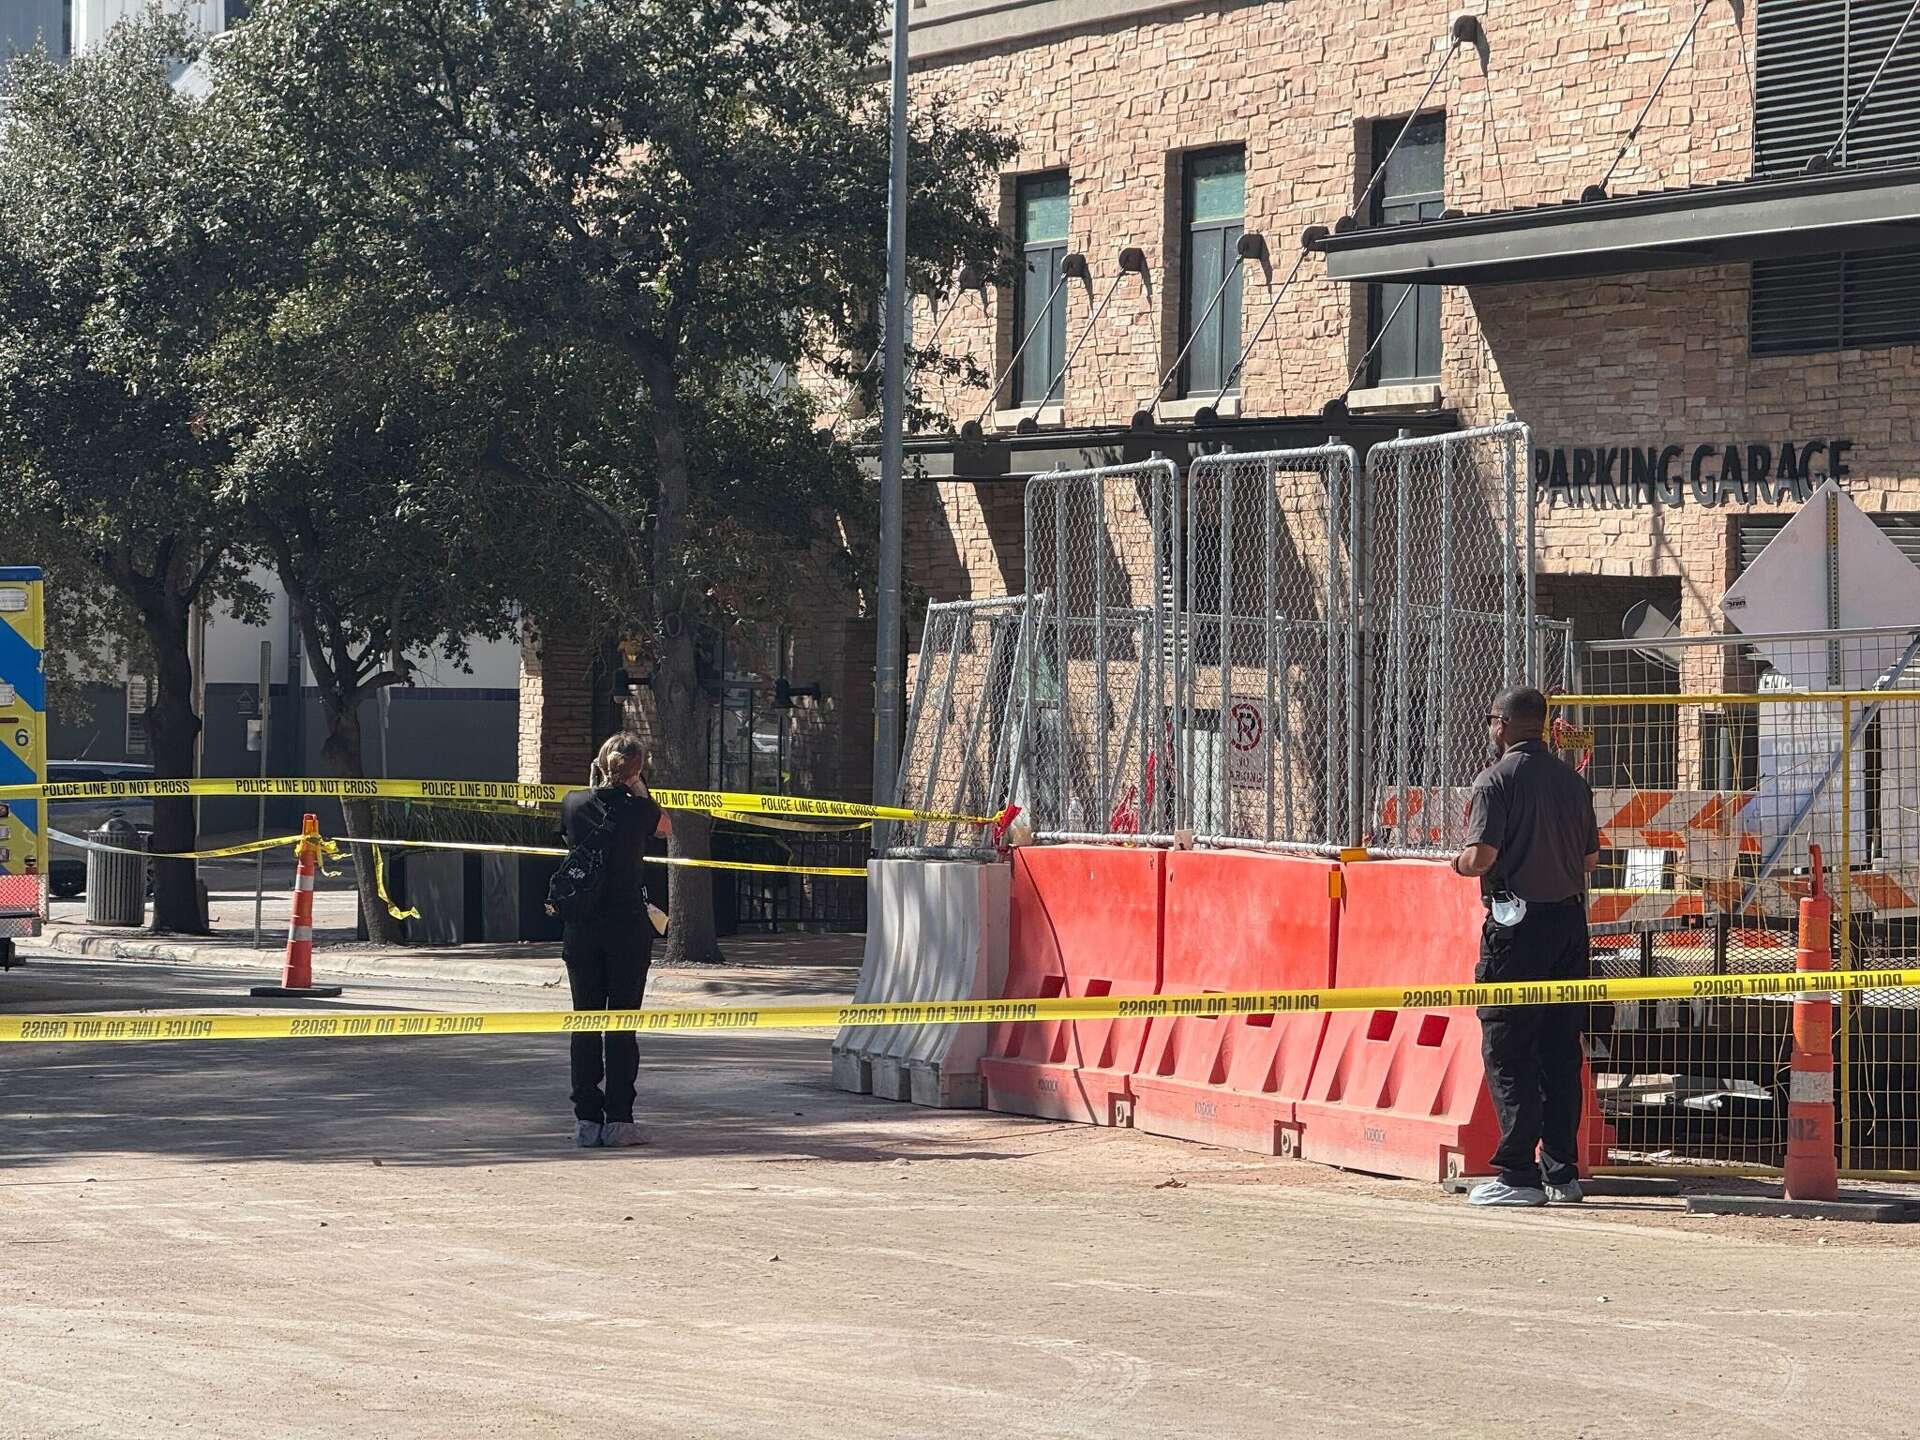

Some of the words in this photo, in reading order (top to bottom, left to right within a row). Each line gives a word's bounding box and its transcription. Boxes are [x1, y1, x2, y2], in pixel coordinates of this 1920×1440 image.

[1534, 445, 1685, 511] PARKING
[1690, 440, 1853, 509] GARAGE
[15, 728, 29, 747] 6
[42, 784, 80, 796] POLICE
[83, 783, 107, 795] LINE
[111, 782, 125, 794] DO
[129, 781, 151, 794] NOT
[154, 781, 190, 793] CROSS
[236, 779, 273, 792] POLICE
[276, 779, 299, 792] LINE
[302, 780, 316, 792] DO
[320, 780, 340, 793] NOT
[343, 781, 378, 794] CROSS
[421, 782, 457, 796] POLICE
[459, 783, 481, 797] LINE
[484, 784, 498, 797] DO
[501, 784, 520, 799] NOT
[523, 786, 556, 800] CROSS
[655, 792, 669, 805] DO
[671, 793, 690, 806] NOT
[692, 794, 723, 808] CROSS
[761, 797, 793, 812] POLICE
[794, 800, 815, 813] LINE
[816, 802, 829, 814] DO
[830, 803, 850, 815] NOT
